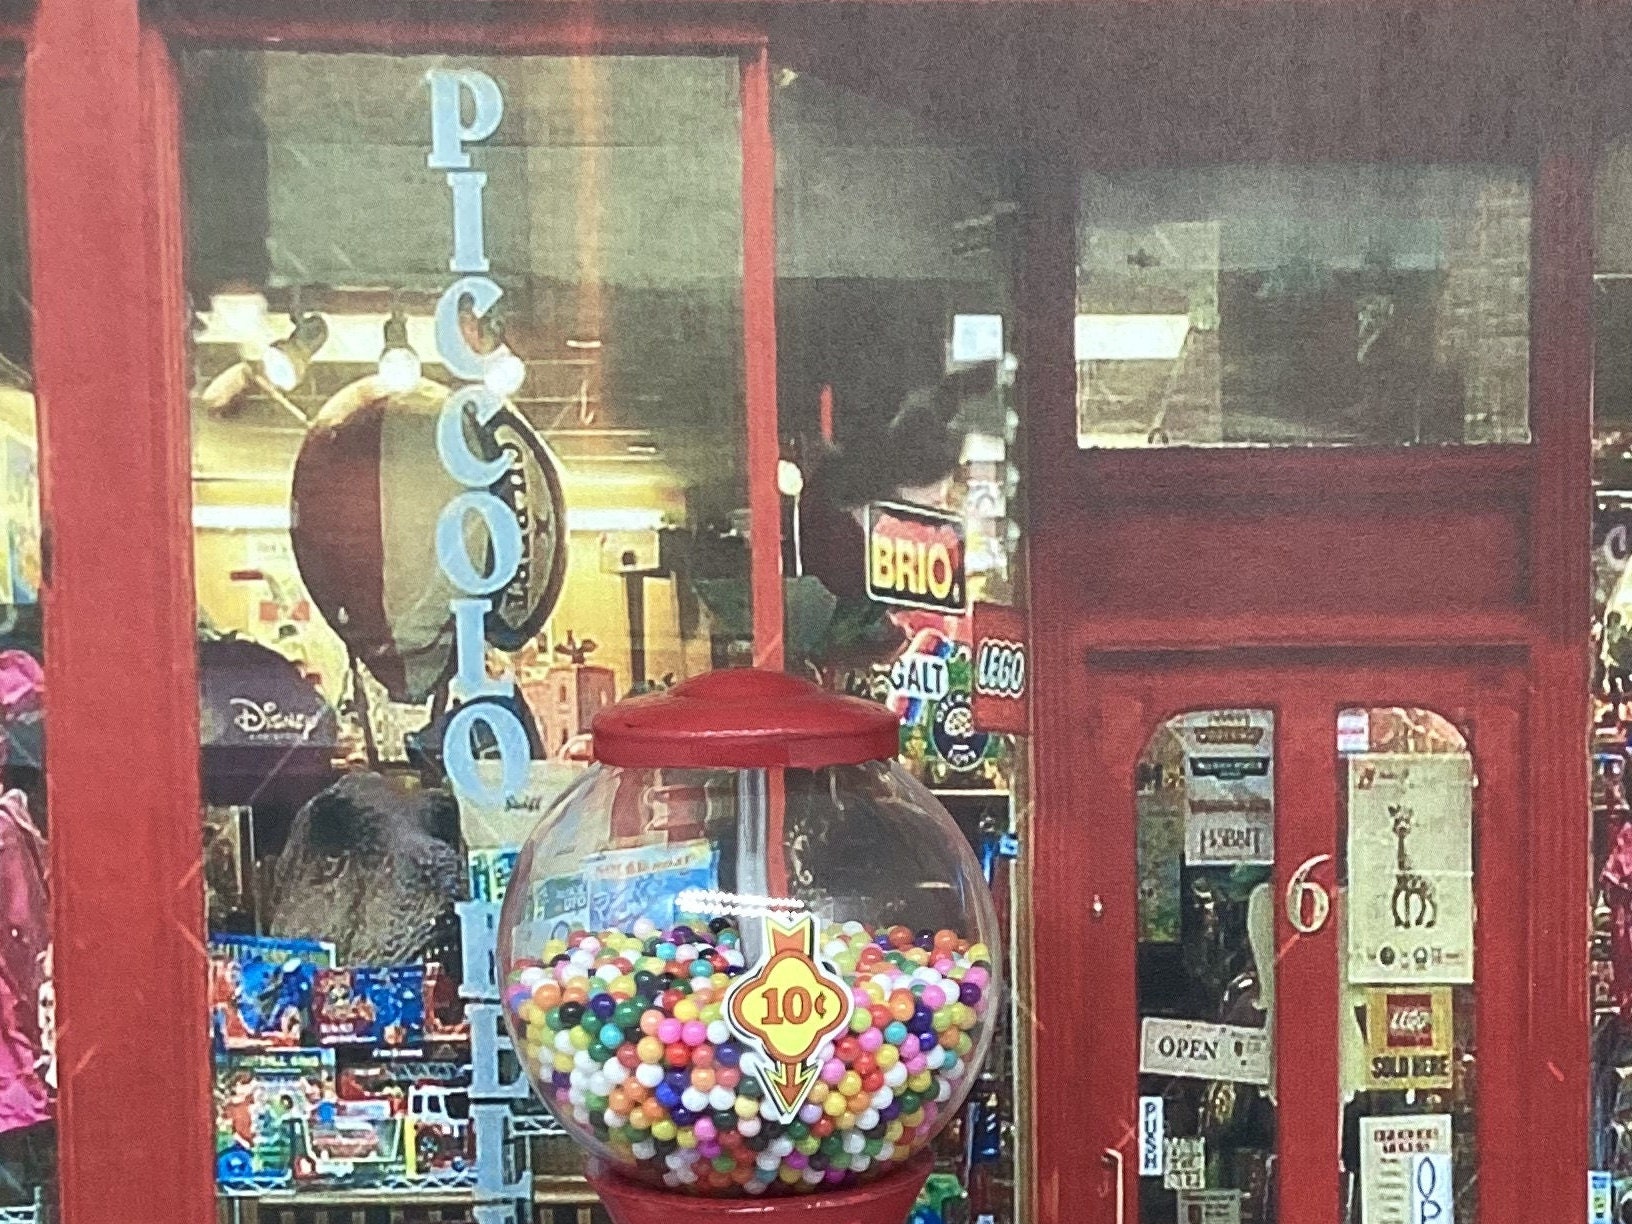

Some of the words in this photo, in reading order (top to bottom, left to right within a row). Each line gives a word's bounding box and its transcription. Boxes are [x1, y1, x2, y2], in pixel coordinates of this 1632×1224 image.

[427, 68, 532, 811] PICCOLO
[871, 532, 953, 600] BRIO
[891, 659, 943, 694] GALT
[978, 644, 1025, 693] LEGO
[229, 697, 330, 740] Disney
[1284, 854, 1332, 933] 6
[761, 986, 827, 1026] 10¢
[1158, 1035, 1218, 1061] OPEN
[1371, 1056, 1409, 1079] SOLD
[1412, 1055, 1449, 1078] HERE
[1144, 1102, 1158, 1169] PUSH
